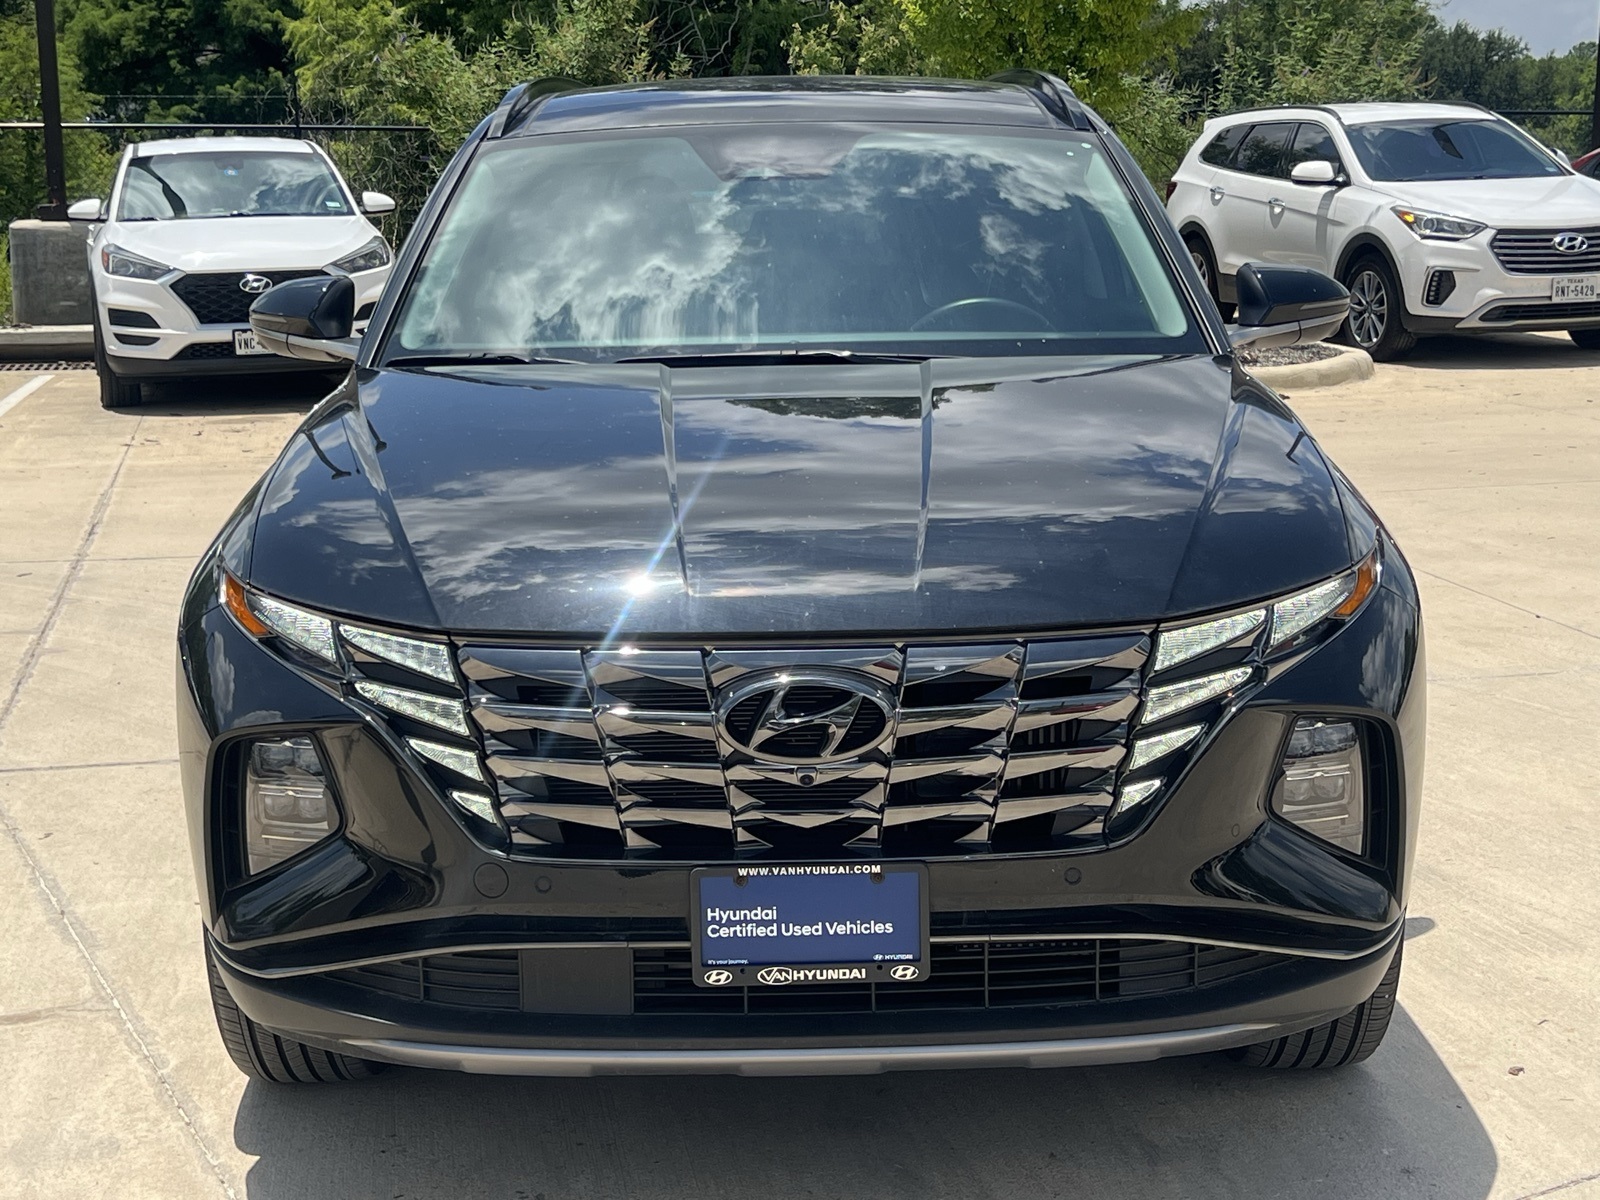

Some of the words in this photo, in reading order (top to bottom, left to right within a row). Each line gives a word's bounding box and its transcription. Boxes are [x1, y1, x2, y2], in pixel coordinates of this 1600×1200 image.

[738, 865, 881, 876] WWW.VANHYUNDAI.COM
[707, 906, 777, 923] Hyundai
[707, 923, 777, 938] Certified
[781, 922, 822, 936] Used
[825, 920, 894, 935] Vehicles
